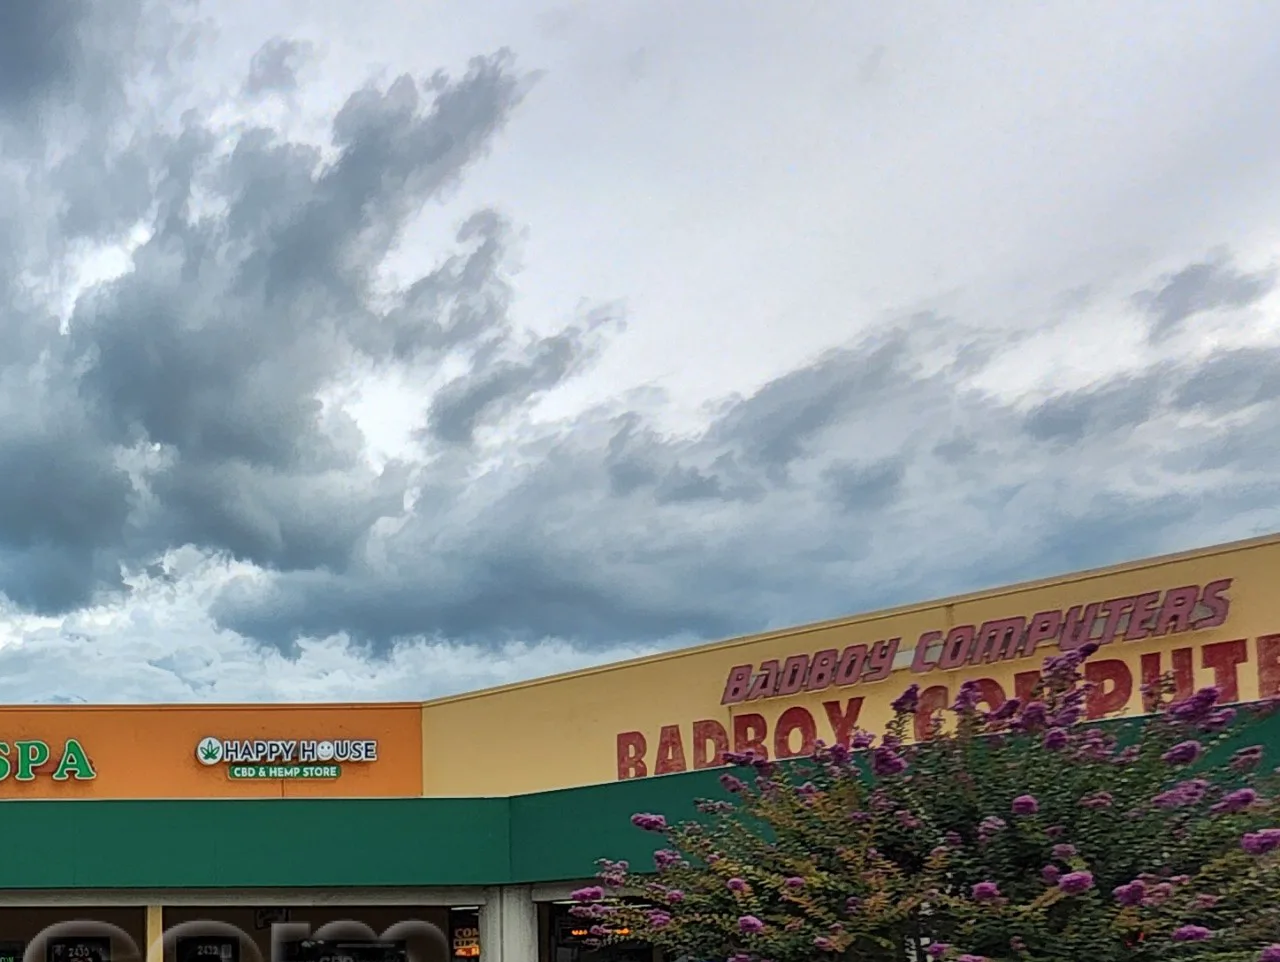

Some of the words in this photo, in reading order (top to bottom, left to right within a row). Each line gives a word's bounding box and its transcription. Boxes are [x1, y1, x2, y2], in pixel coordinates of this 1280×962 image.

[721, 637, 900, 704] BADBOY
[910, 578, 1234, 674] COMPUTERS
[223, 740, 295, 762] HAPPY
[617, 696, 866, 781] BADBOY
[233, 766, 256, 777] CBD
[258, 767, 266, 777] &
[269, 766, 300, 777] HEMP
[303, 766, 337, 777] STORE
